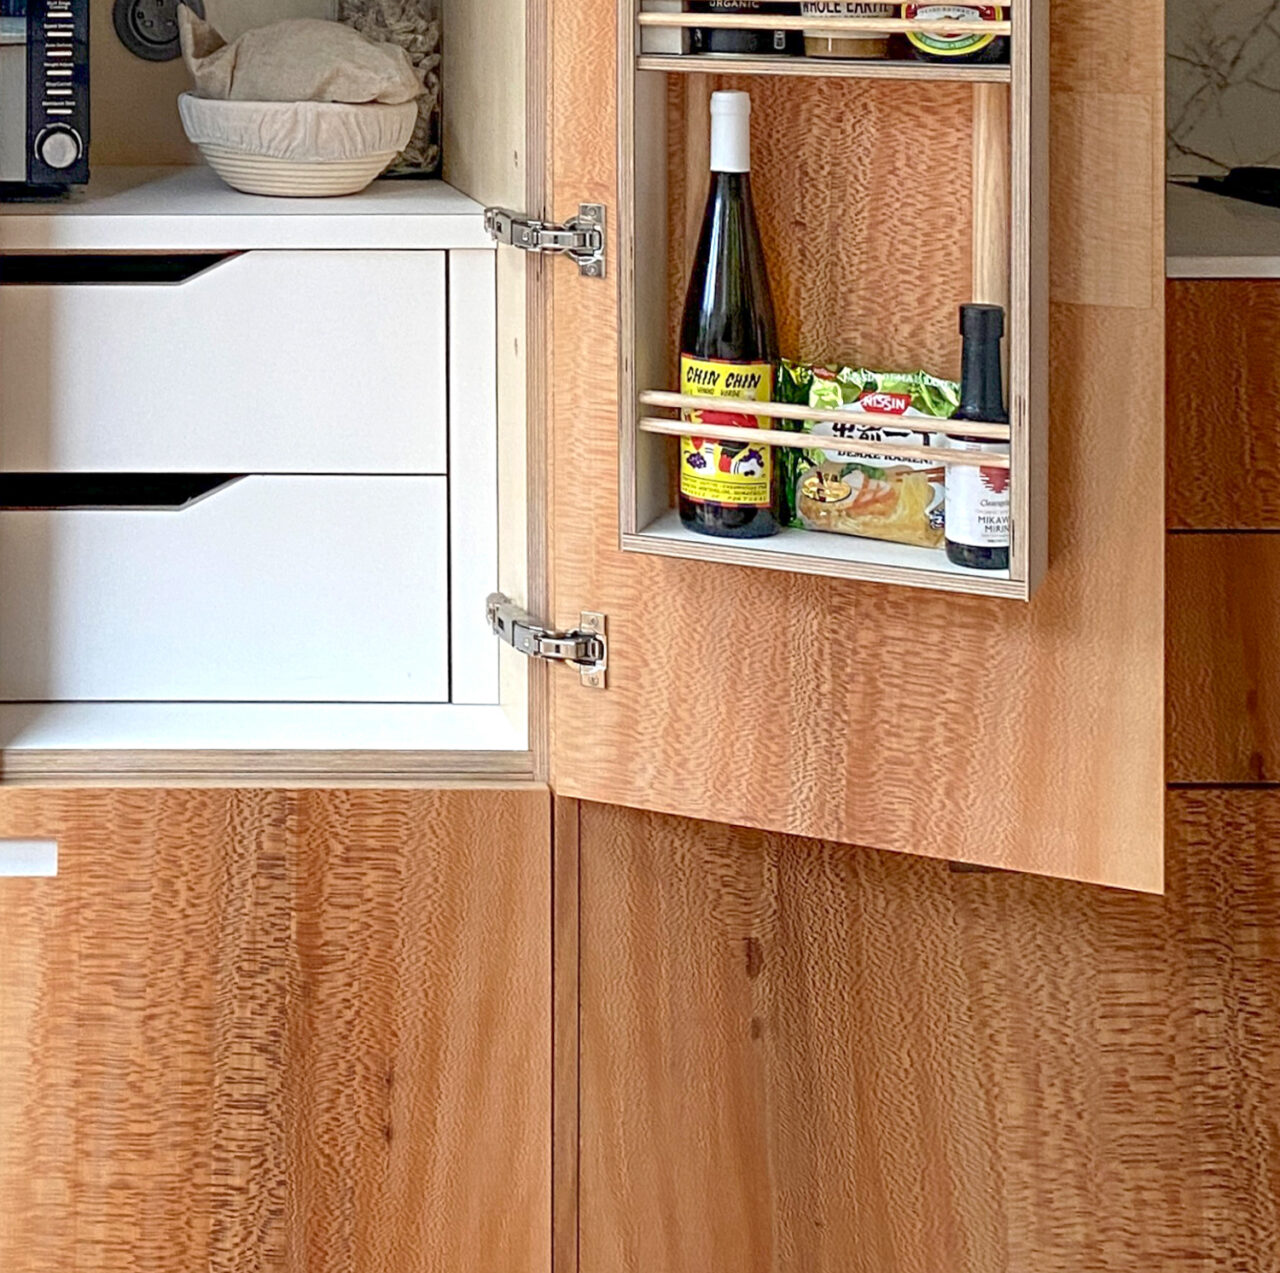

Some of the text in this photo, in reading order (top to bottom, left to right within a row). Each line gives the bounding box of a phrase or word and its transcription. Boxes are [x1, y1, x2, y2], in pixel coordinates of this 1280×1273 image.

[686, 366, 762, 389] CHIN CHIN
[862, 393, 906, 411] NISSIN
[978, 515, 1009, 524] MIKAW
